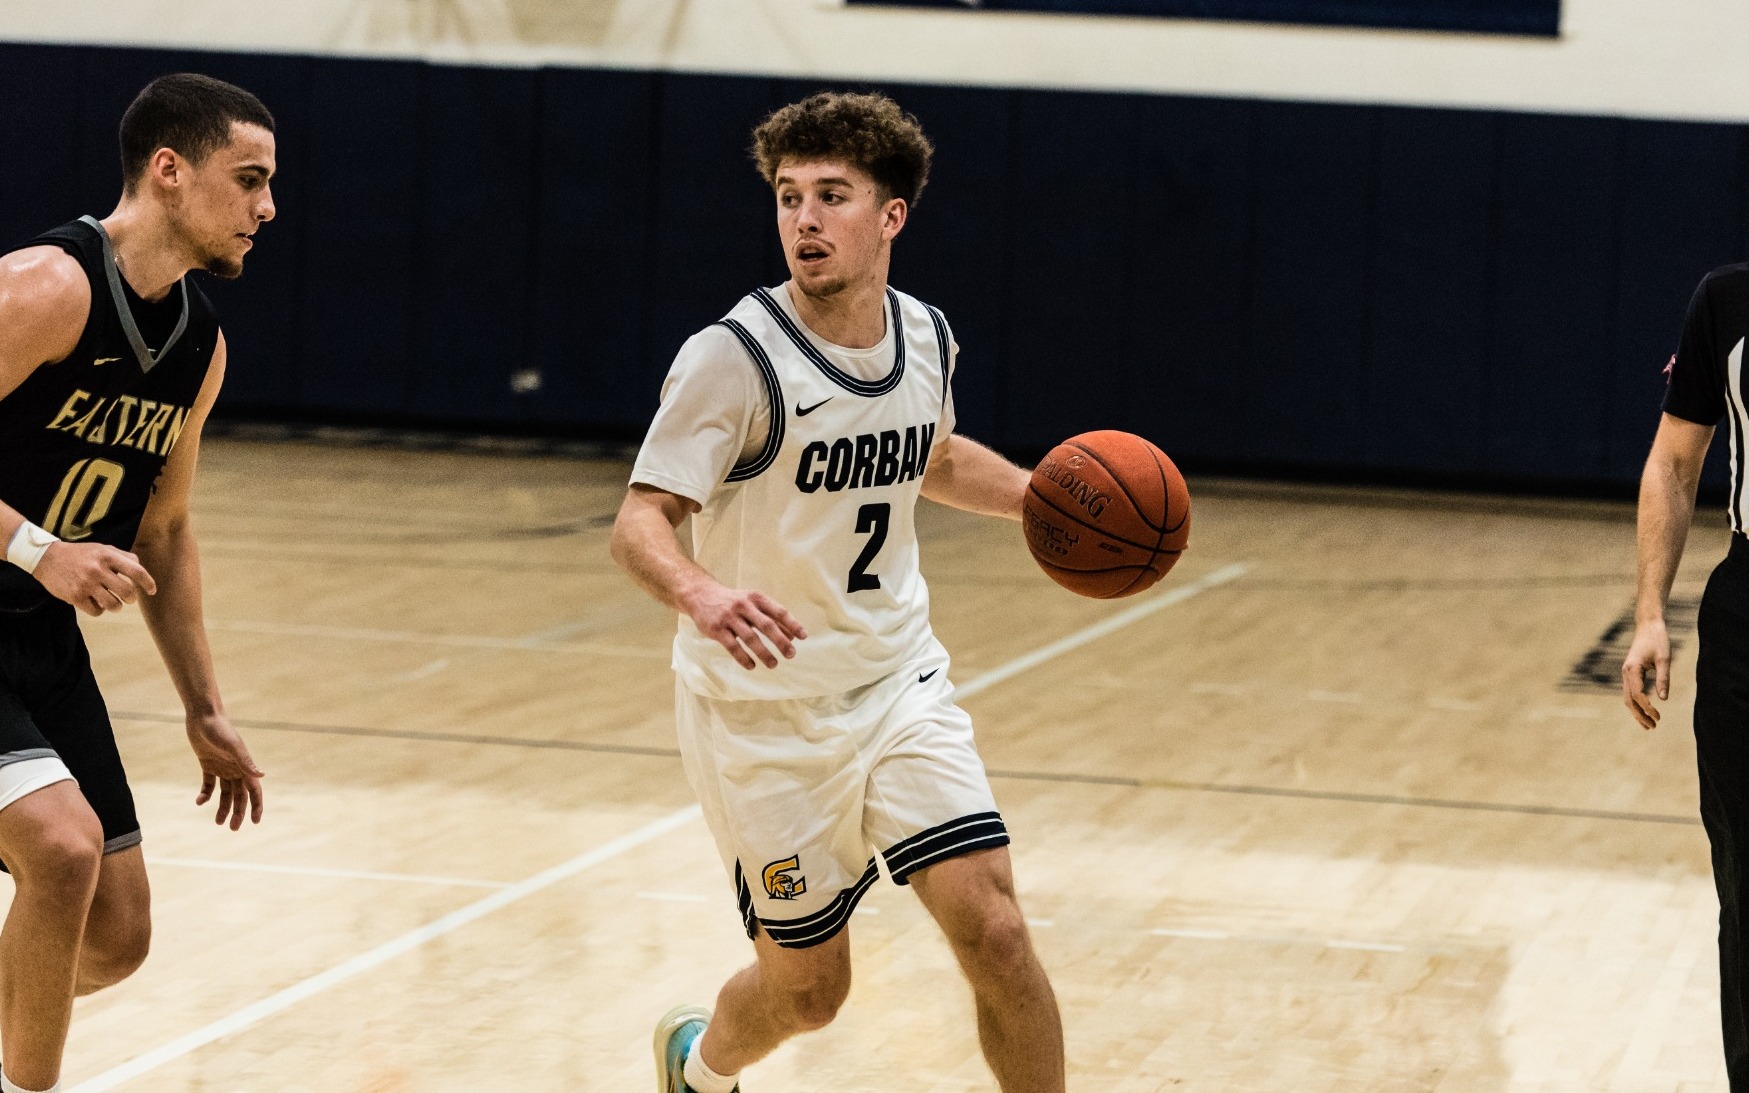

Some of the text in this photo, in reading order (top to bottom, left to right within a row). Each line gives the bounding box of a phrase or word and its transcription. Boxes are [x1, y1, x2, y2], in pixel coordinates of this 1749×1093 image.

[45, 388, 191, 456] EASTERN
[794, 422, 936, 494] CORBAN
[42, 457, 125, 541] 10
[846, 502, 891, 593] 2
